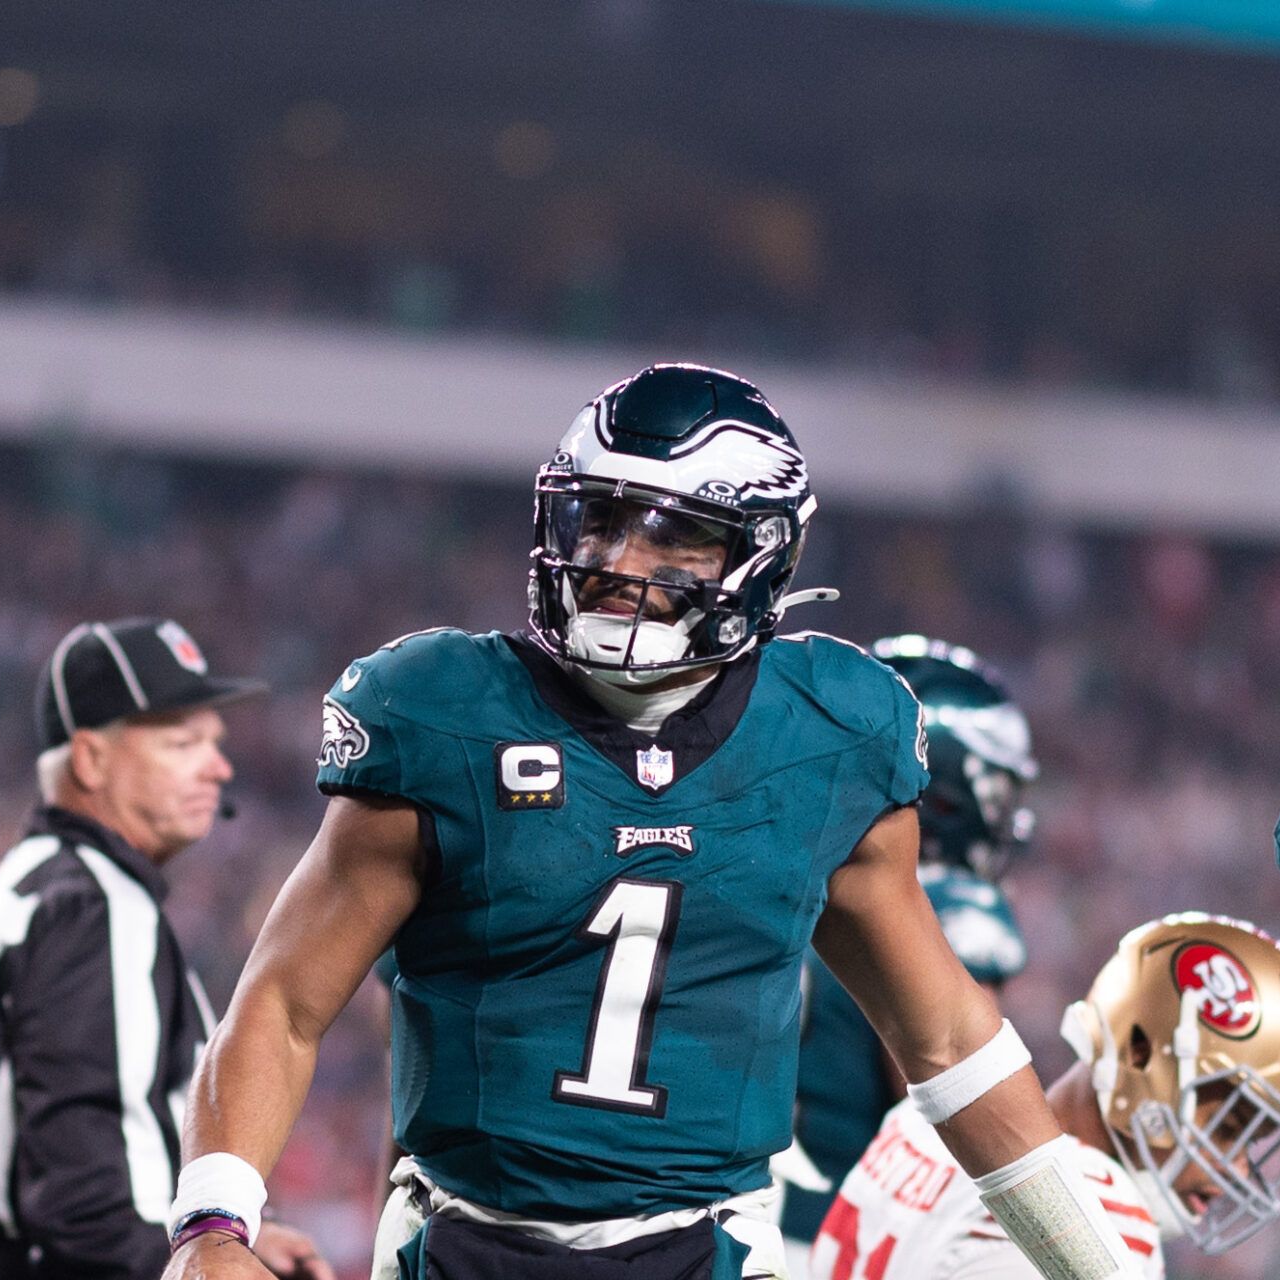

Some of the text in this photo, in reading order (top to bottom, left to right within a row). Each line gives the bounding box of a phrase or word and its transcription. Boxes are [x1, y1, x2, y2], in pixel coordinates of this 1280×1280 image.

[501, 745, 560, 791] C
[616, 825, 694, 854] EAGLES
[558, 881, 672, 1110] 1
